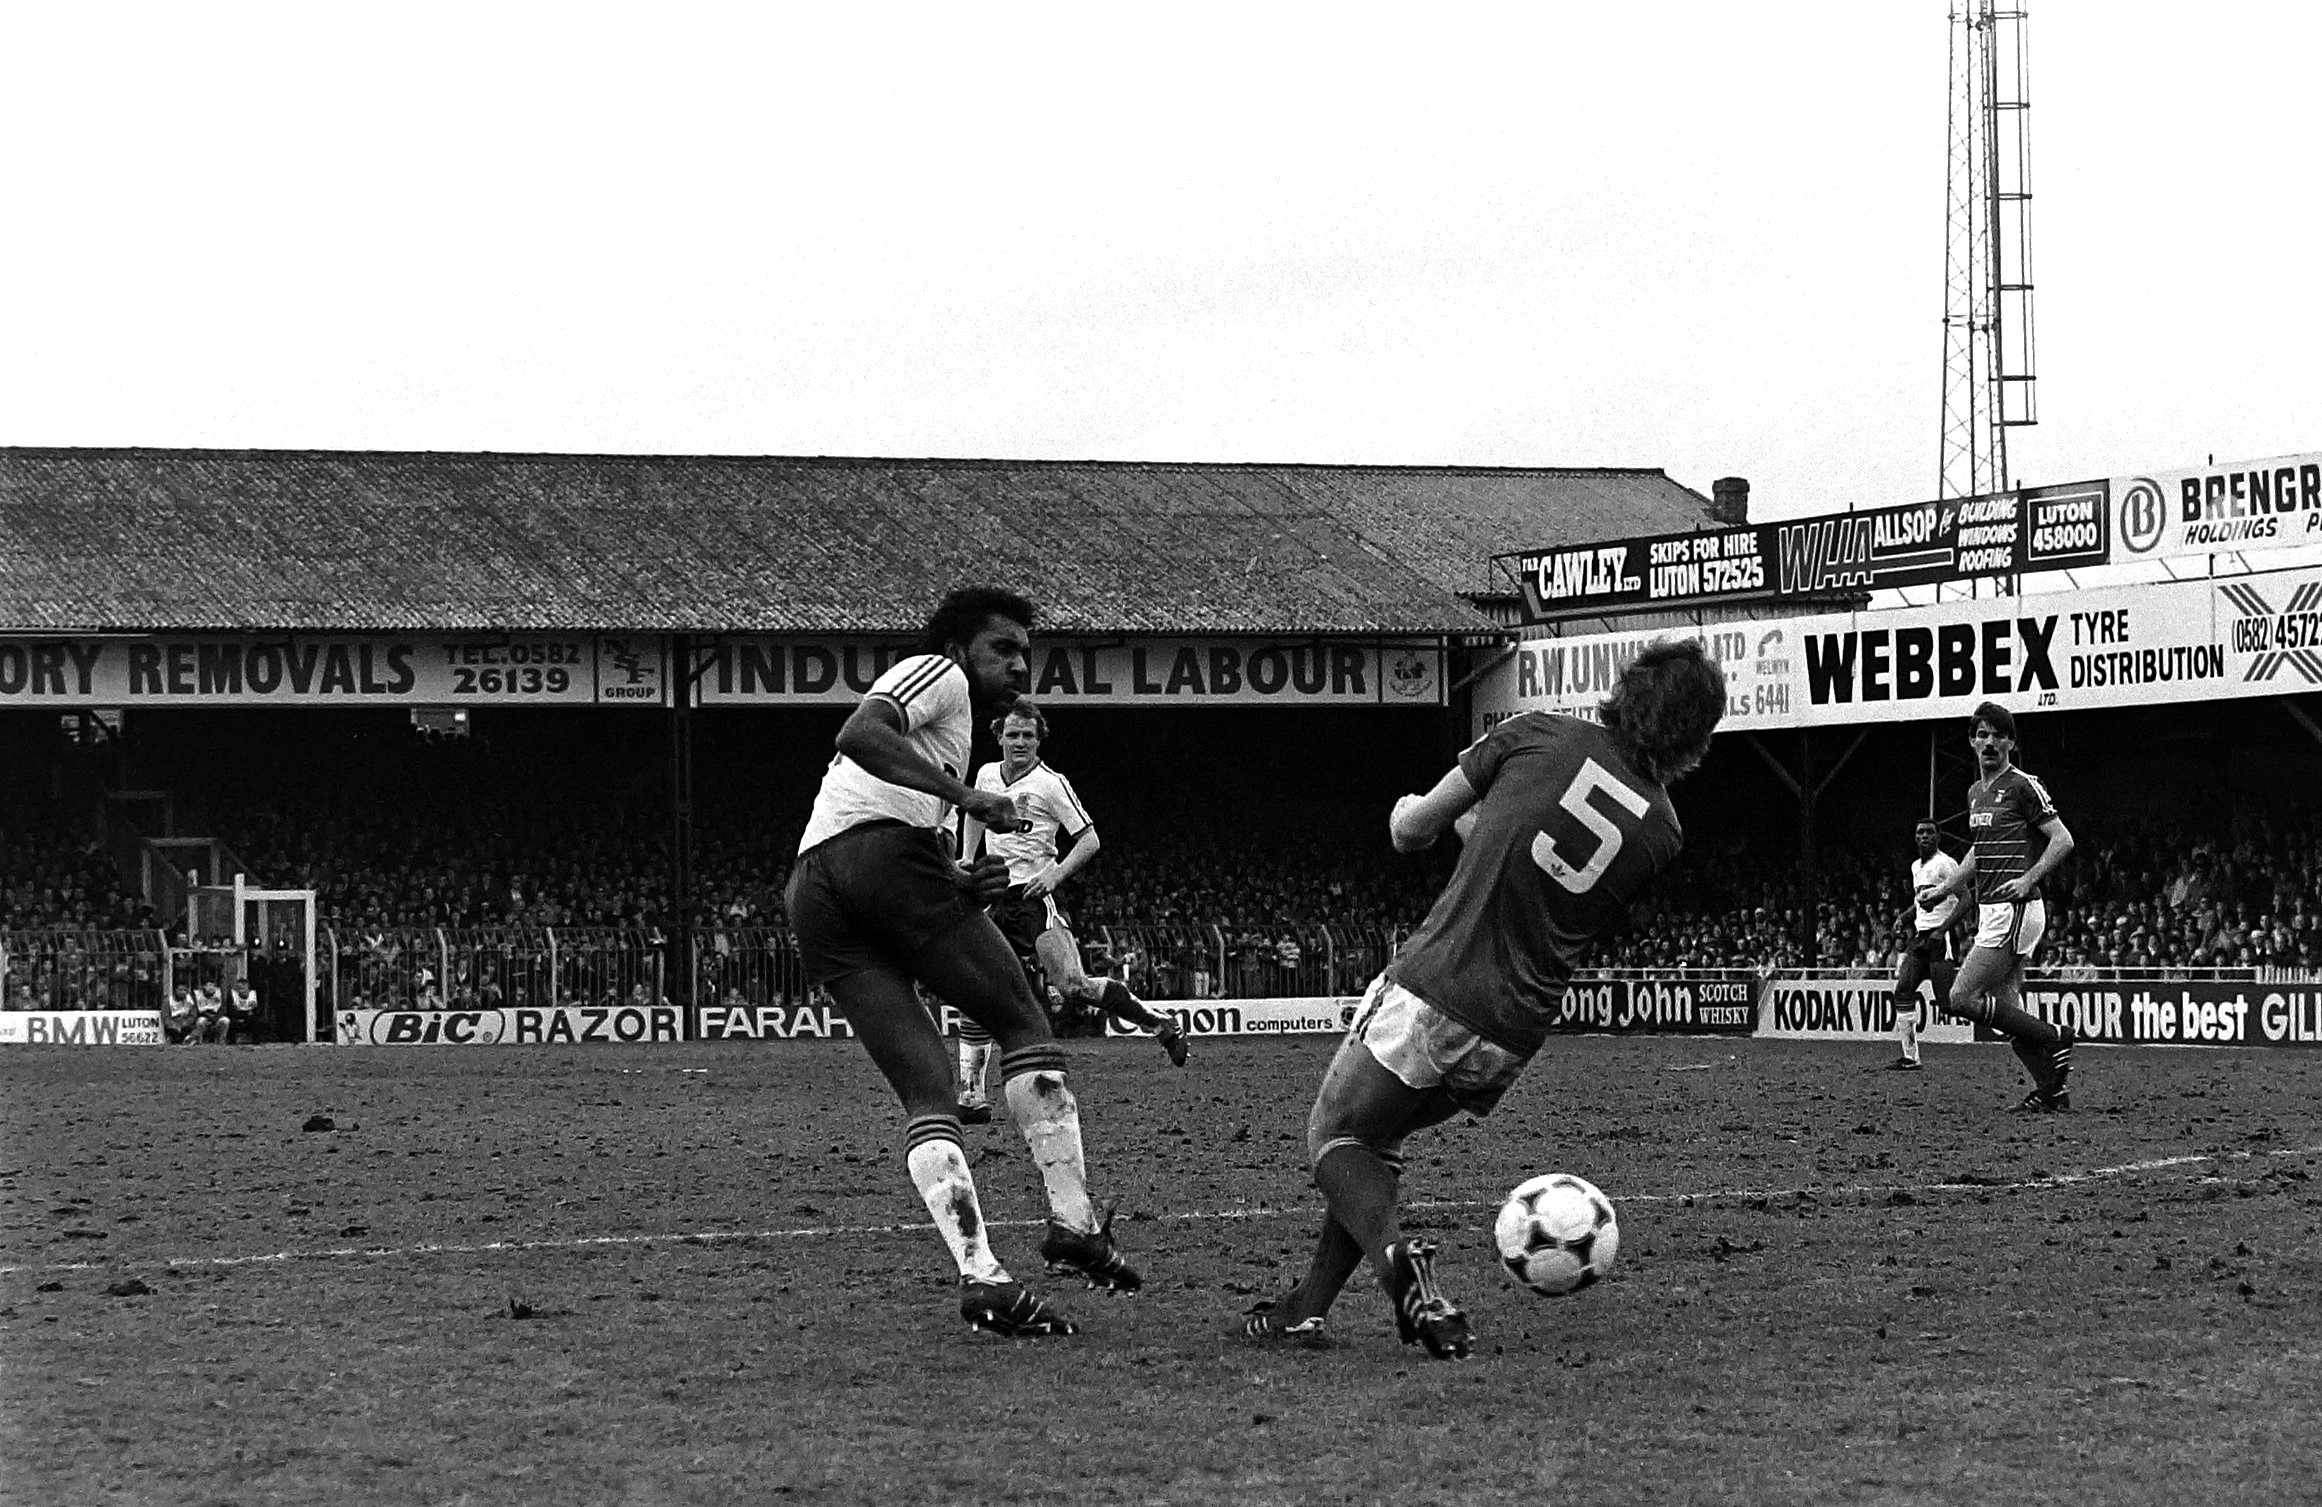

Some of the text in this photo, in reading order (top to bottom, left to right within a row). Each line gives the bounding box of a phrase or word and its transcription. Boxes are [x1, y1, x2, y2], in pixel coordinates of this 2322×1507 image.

[1874, 508, 1937, 548] ALLSOP
[1958, 498, 2018, 525] BUILDING
[2038, 501, 2094, 526] LUTON
[1958, 523, 2018, 548] WINDOWS
[2032, 522, 2097, 552] 458000
[2185, 517, 2278, 546] HOLDINGS
[1650, 532, 1758, 565] SKIPS FOR HIRE
[1958, 546, 2013, 573] ROOFING
[1538, 547, 1627, 600] CAWLEY
[1650, 555, 1764, 599] LUTON 572525
[2070, 609, 2129, 645] TYRE
[2275, 612, 2322, 650] 4572
[128, 643, 415, 695] REMOVALS
[1132, 646, 1367, 695] LABOUR
[1804, 615, 2060, 705] WEBBEX
[2070, 643, 2224, 688] DISTRIBUTION
[453, 667, 571, 694] 26139
[604, 686, 656, 699] GROUP
[1531, 756, 1651, 894] 5
[1551, 981, 1693, 1028] ong John
[1699, 983, 1749, 1002] SCOTCH
[122, 1017, 160, 1029] LUTON
[385, 1008, 678, 1044] BiC RAZOR
[701, 1006, 855, 1039] FARAH
[1246, 1017, 1333, 1035] computers
[1699, 1006, 1750, 1025] WHISKY
[1773, 989, 1854, 1032] KODAK
[2130, 991, 2178, 1040] the
[2182, 991, 2249, 1041] best
[27, 1016, 120, 1046] BMW
[121, 1032, 158, 1044] 56622
